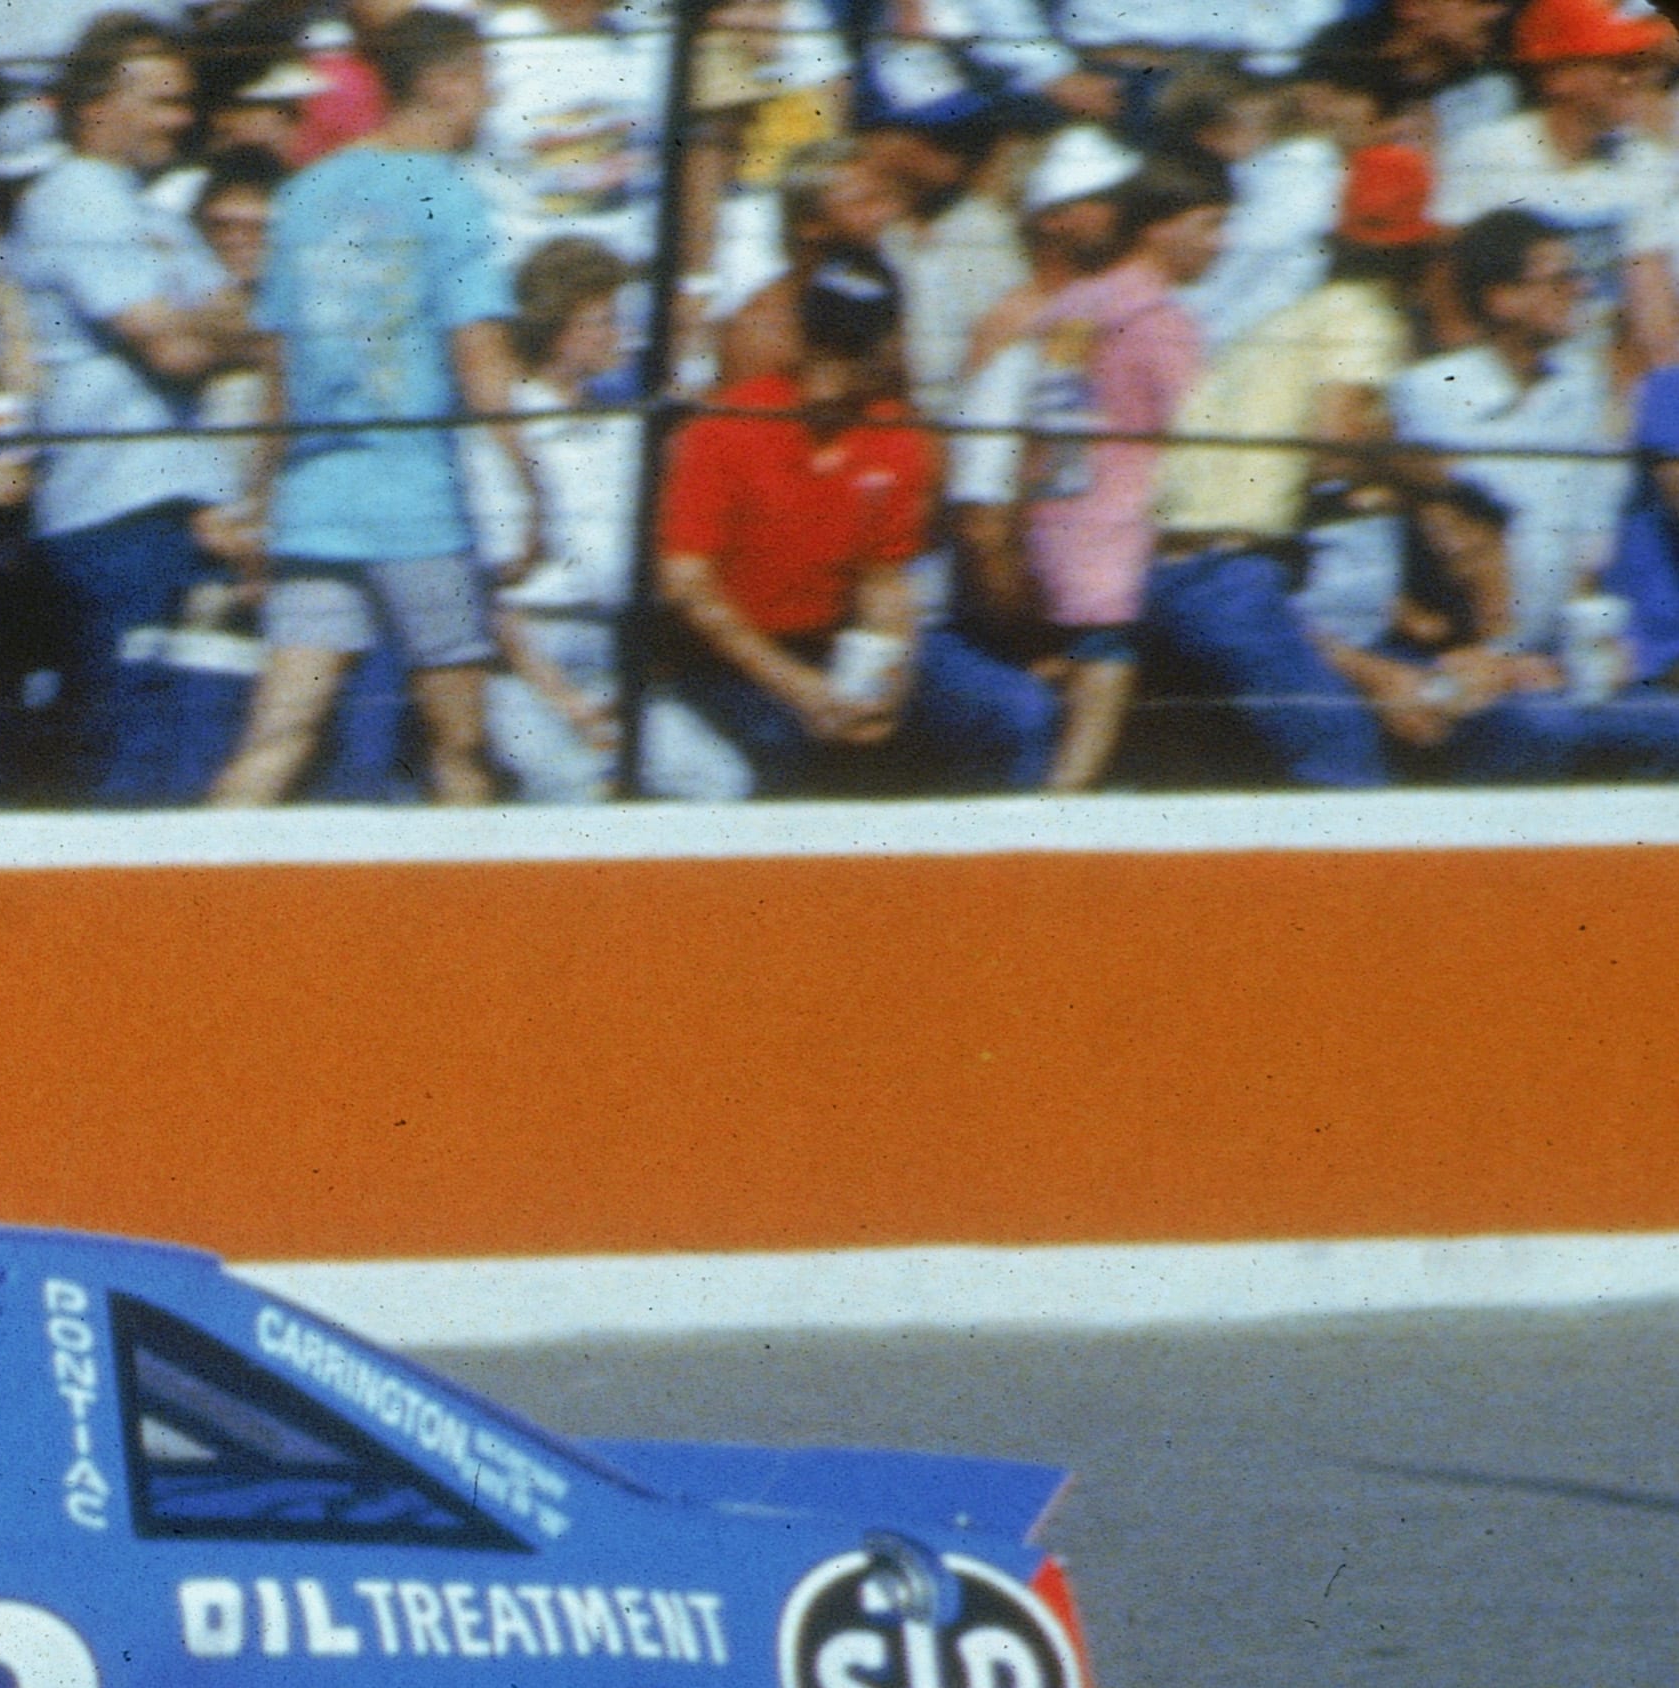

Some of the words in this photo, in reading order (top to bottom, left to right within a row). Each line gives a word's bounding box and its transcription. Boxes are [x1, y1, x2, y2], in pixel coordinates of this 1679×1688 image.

[44, 1277, 112, 1531] PONTIAC
[257, 1304, 469, 1462] CARRINGTON
[179, 1574, 361, 1659] OIL
[356, 1577, 730, 1668] TREATMENT
